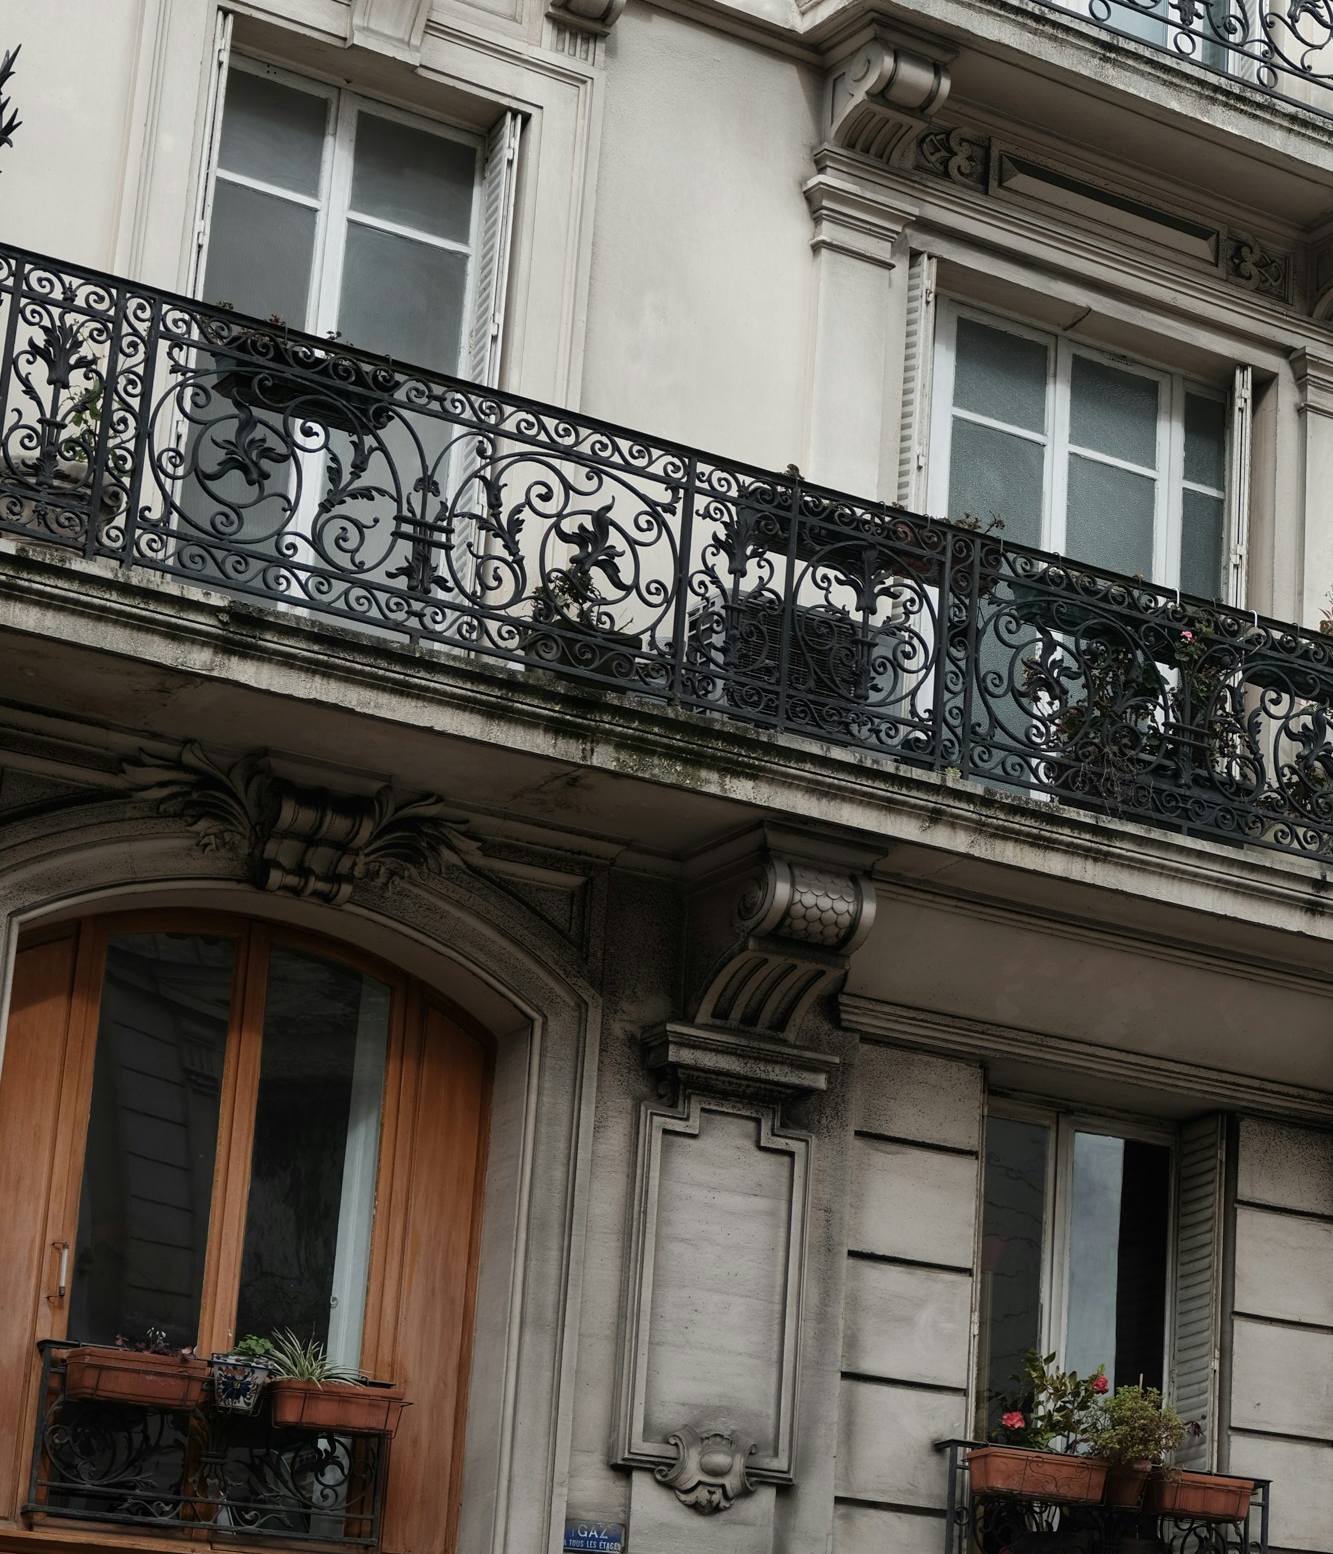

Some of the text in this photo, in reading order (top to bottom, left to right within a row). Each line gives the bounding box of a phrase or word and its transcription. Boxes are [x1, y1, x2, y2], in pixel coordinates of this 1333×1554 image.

[577, 1524, 608, 1539] GAZ
[569, 1539, 584, 1548] TOUS
[586, 1540, 597, 1549] LES
